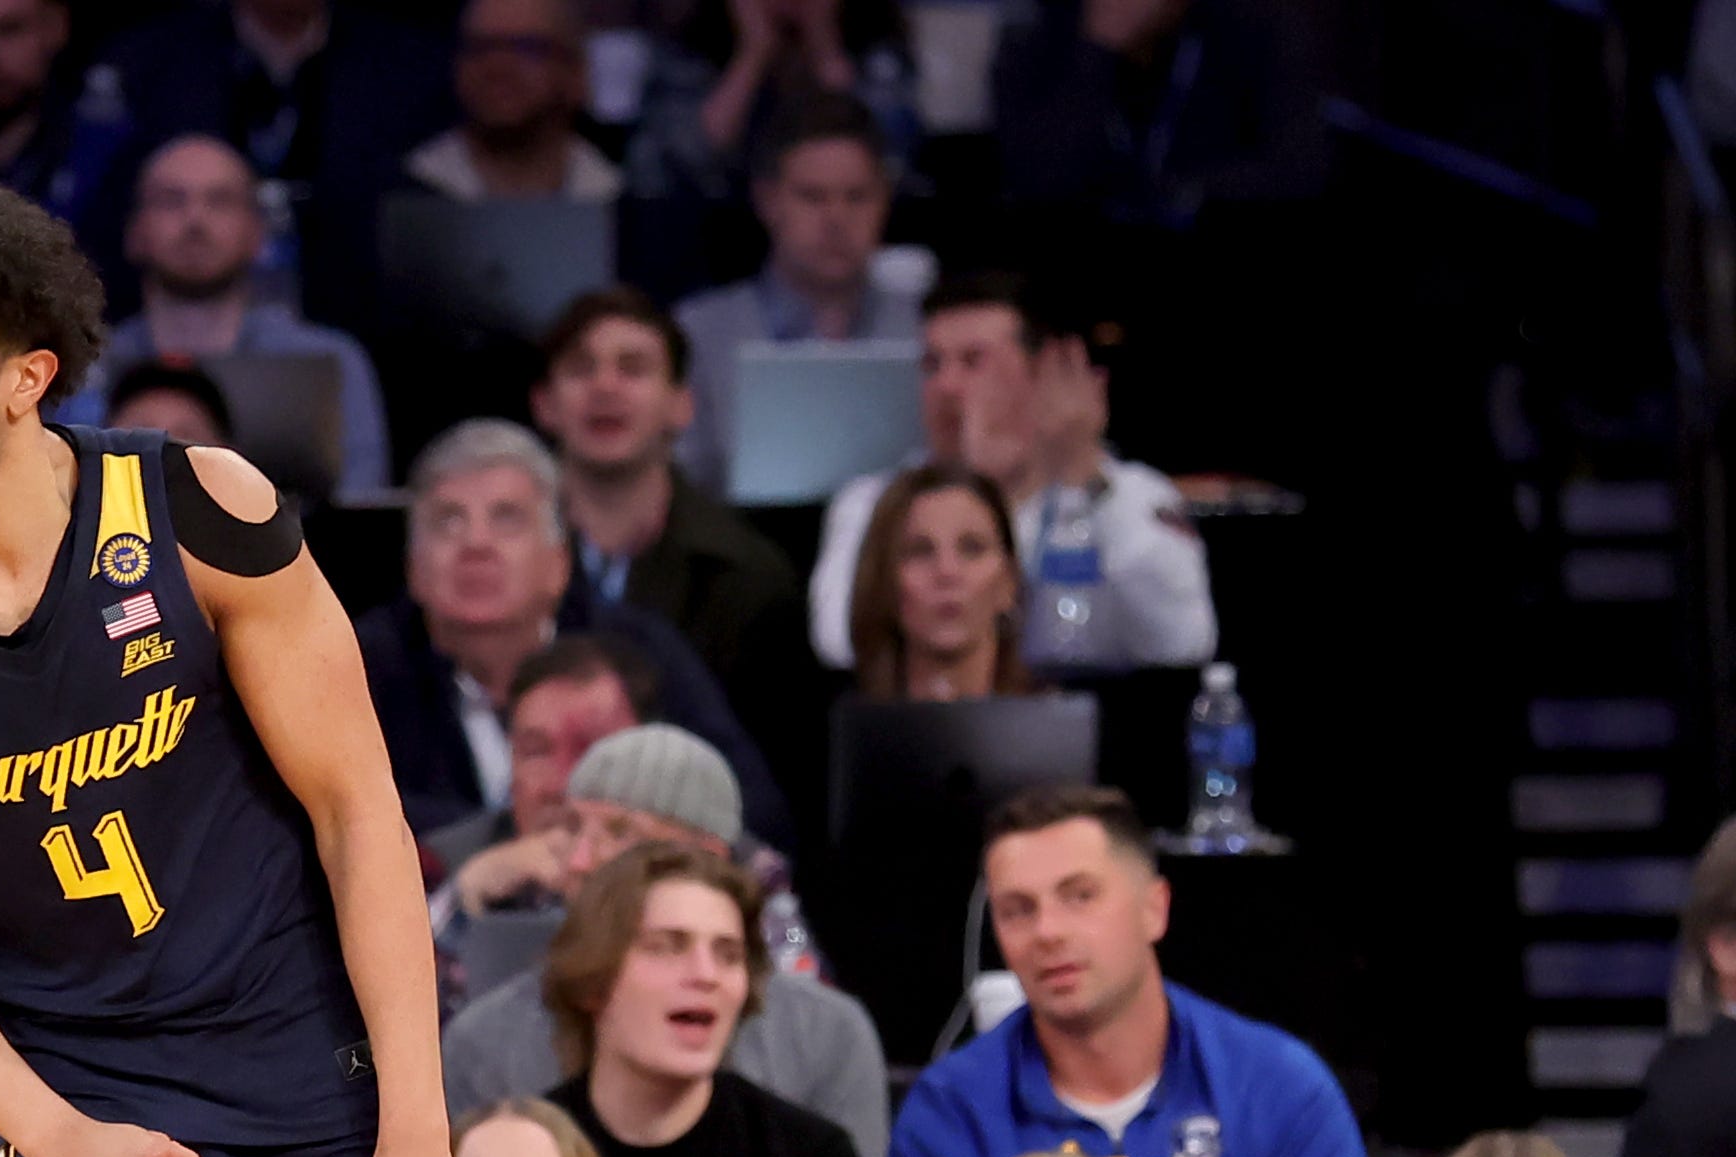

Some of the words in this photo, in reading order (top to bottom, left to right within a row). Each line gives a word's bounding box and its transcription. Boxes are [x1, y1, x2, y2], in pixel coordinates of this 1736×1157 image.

[122, 640, 175, 670] EAST
[124, 632, 161, 656] BIG
[39, 809, 166, 938] 4
